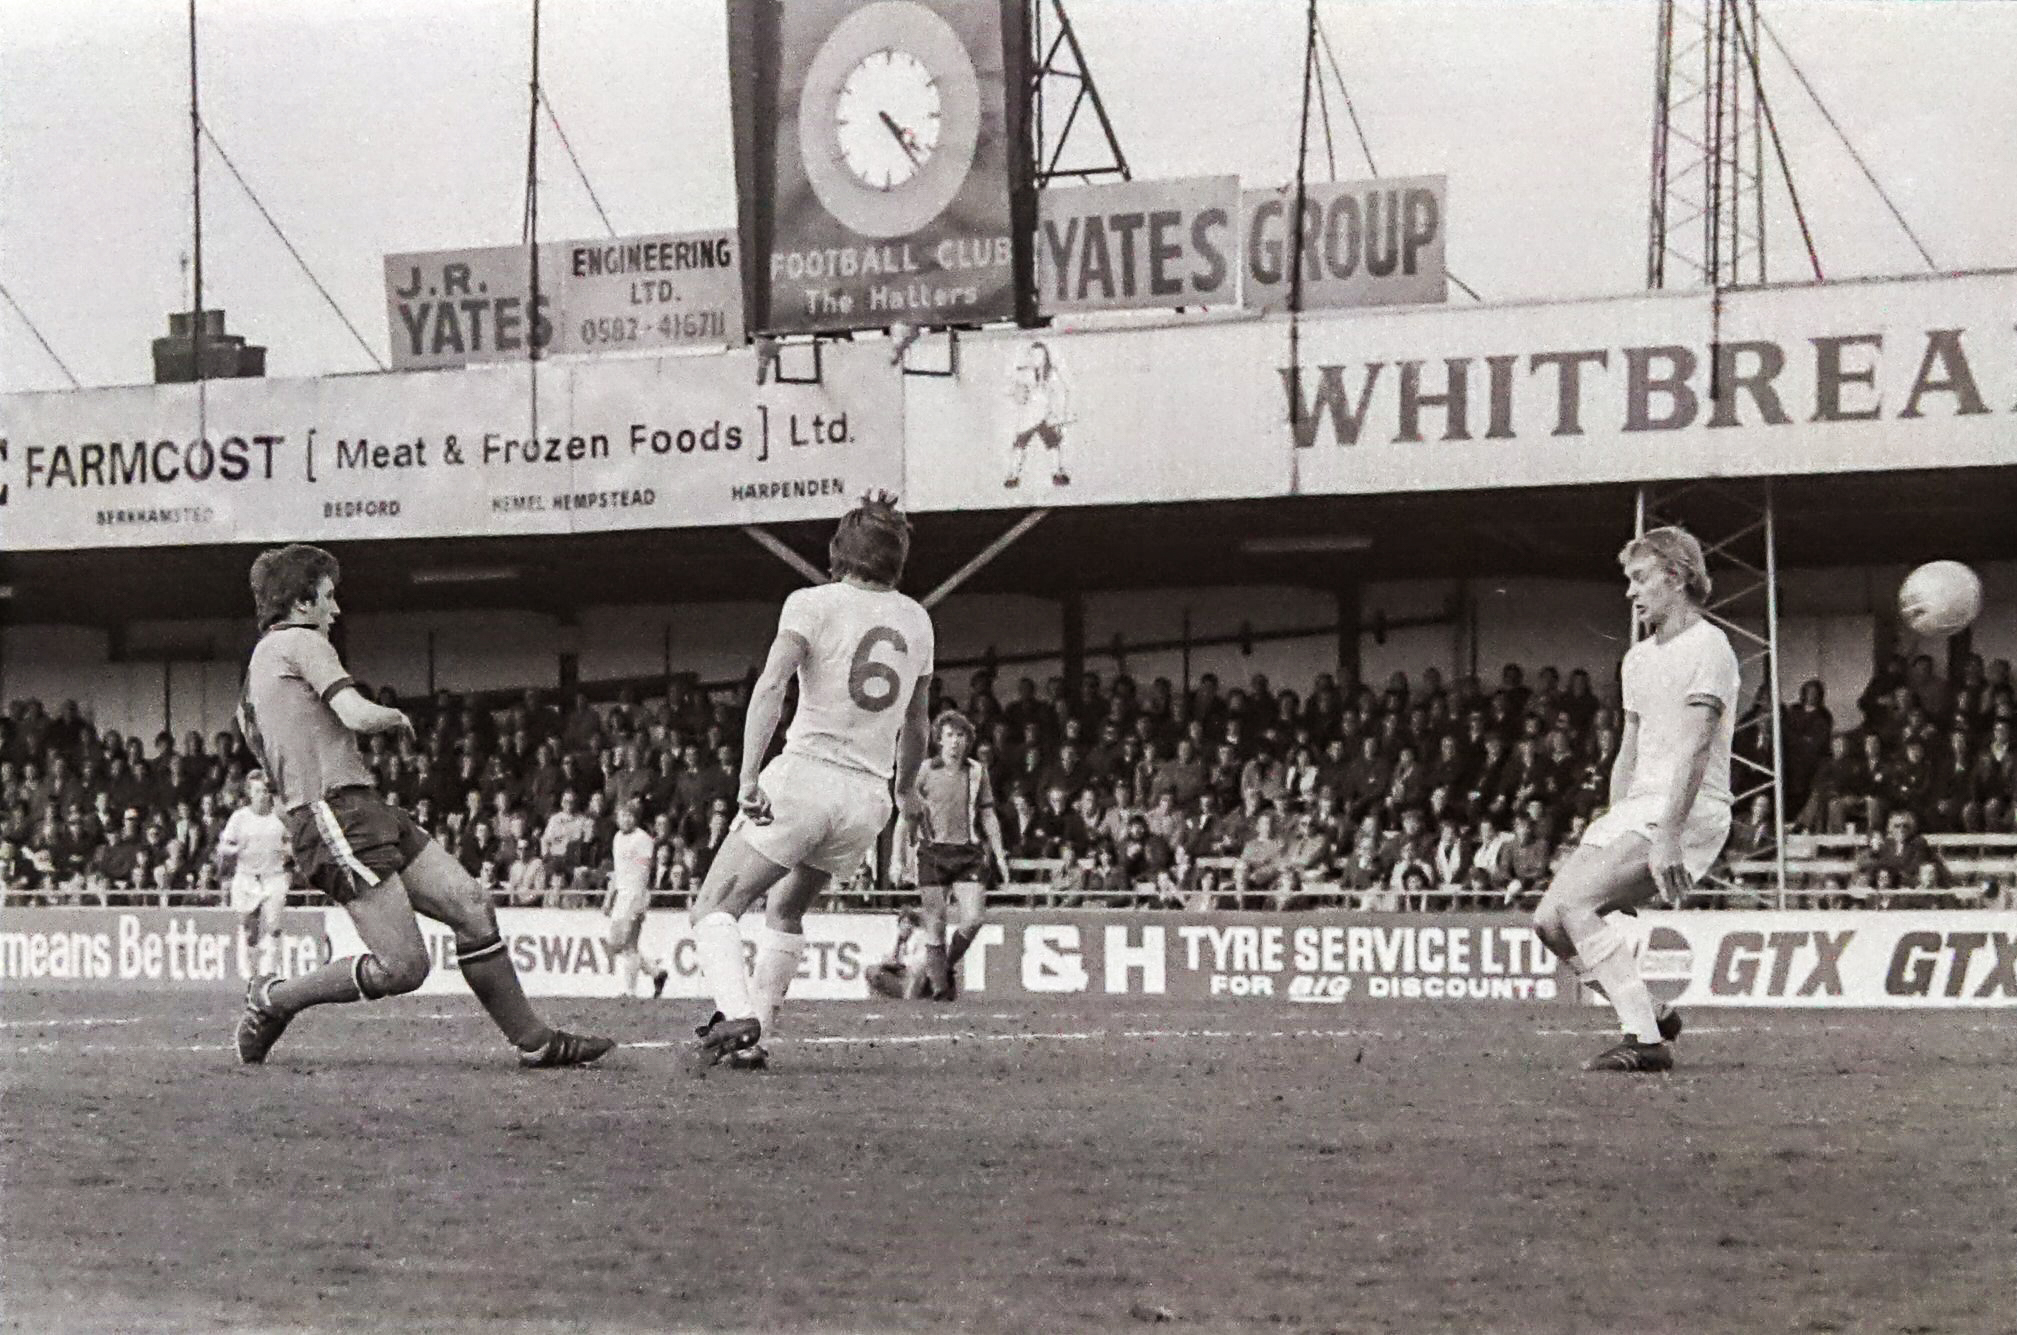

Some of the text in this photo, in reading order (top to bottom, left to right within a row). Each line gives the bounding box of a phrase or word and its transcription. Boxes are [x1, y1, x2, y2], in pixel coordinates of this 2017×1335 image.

[572, 237, 732, 278] ENGINEERING
[770, 236, 1013, 281] FOOTBALL CLUB
[1044, 188, 1439, 300] YATES GROUP
[396, 262, 488, 298] J.R.
[630, 279, 682, 305] LTD.
[804, 288, 854, 315] The
[399, 293, 553, 356] YATES
[1276, 323, 2017, 449] WHITBREA
[27, 435, 285, 489] FARMCOST
[336, 436, 428, 470] Meat
[443, 434, 465, 466] &
[482, 433, 610, 465] Frozen
[630, 420, 743, 454] Foods
[323, 500, 401, 518] BEDFORD
[553, 487, 656, 511] HEMPSTEAD
[731, 477, 845, 501] HARPENDEN
[848, 625, 909, 713] 6
[0, 932, 113, 979] means
[118, 914, 232, 981] Better
[1021, 924, 1090, 993] &
[1104, 924, 1166, 995] H
[1178, 926, 1285, 974] TYRE
[1293, 926, 1471, 975] SERVICE
[1481, 927, 1559, 975] LTD
[1709, 930, 1857, 998] GTX
[1884, 930, 2017, 998] GTX
[1210, 975, 1558, 1000] FOR BIG DISCOUNTS
